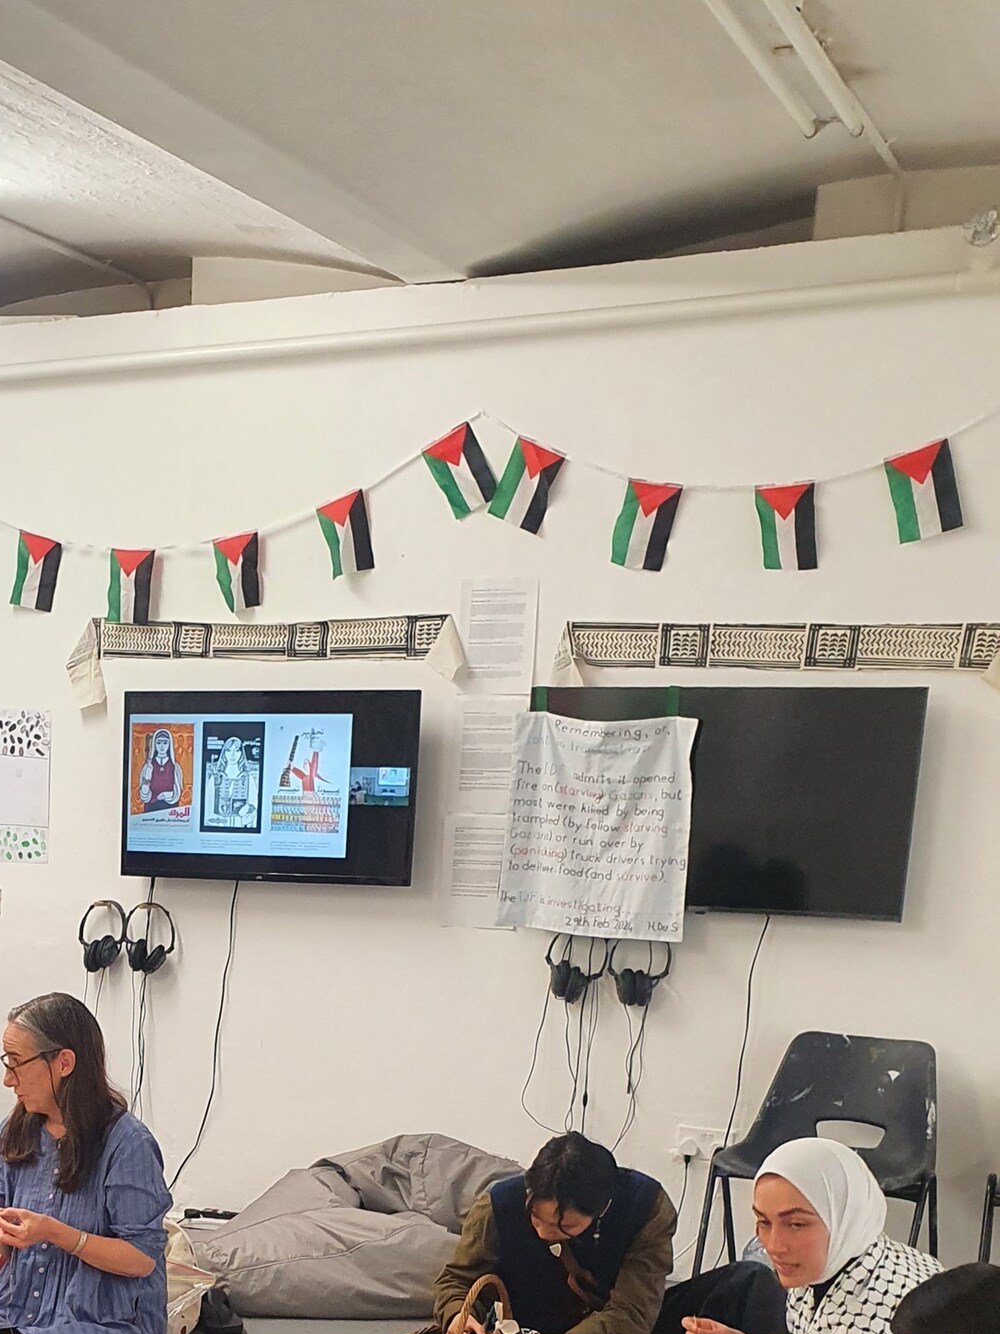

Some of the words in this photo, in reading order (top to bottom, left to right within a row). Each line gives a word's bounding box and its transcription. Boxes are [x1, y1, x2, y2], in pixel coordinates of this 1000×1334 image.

[516, 777, 538, 792] fire
[660, 786, 682, 801] but
[573, 771, 612, 786] admits
[632, 771, 676, 788] opened
[513, 797, 543, 809] most
[547, 801, 576, 812] were
[615, 803, 630, 821] by
[633, 802, 665, 823] being
[623, 820, 669, 839] starving
[572, 836, 594, 847] run
[599, 839, 627, 849] over
[629, 835, 644, 854] by
[570, 849, 601, 864] truck
[605, 852, 646, 866] drivers
[649, 854, 687, 872] trying
